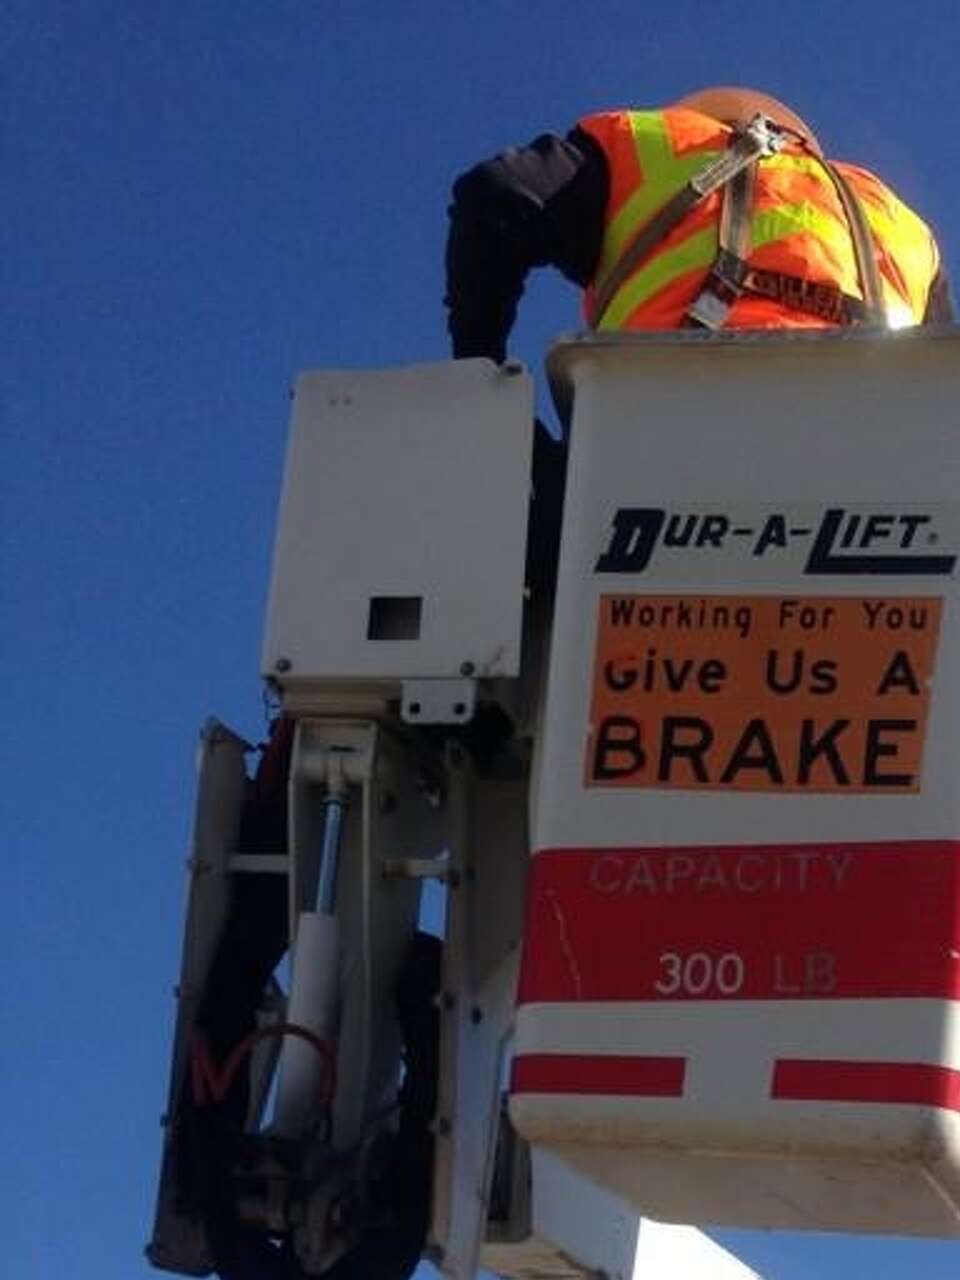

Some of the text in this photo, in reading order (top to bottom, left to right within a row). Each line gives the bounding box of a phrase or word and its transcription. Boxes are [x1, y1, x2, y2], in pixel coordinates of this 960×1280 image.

[611, 600, 927, 638] Working For You
[604, 649, 920, 696] Give Us A
[593, 715, 917, 787] BRAKE
[588, 851, 854, 895] CAPACITY
[654, 951, 838, 994] 300 LB
